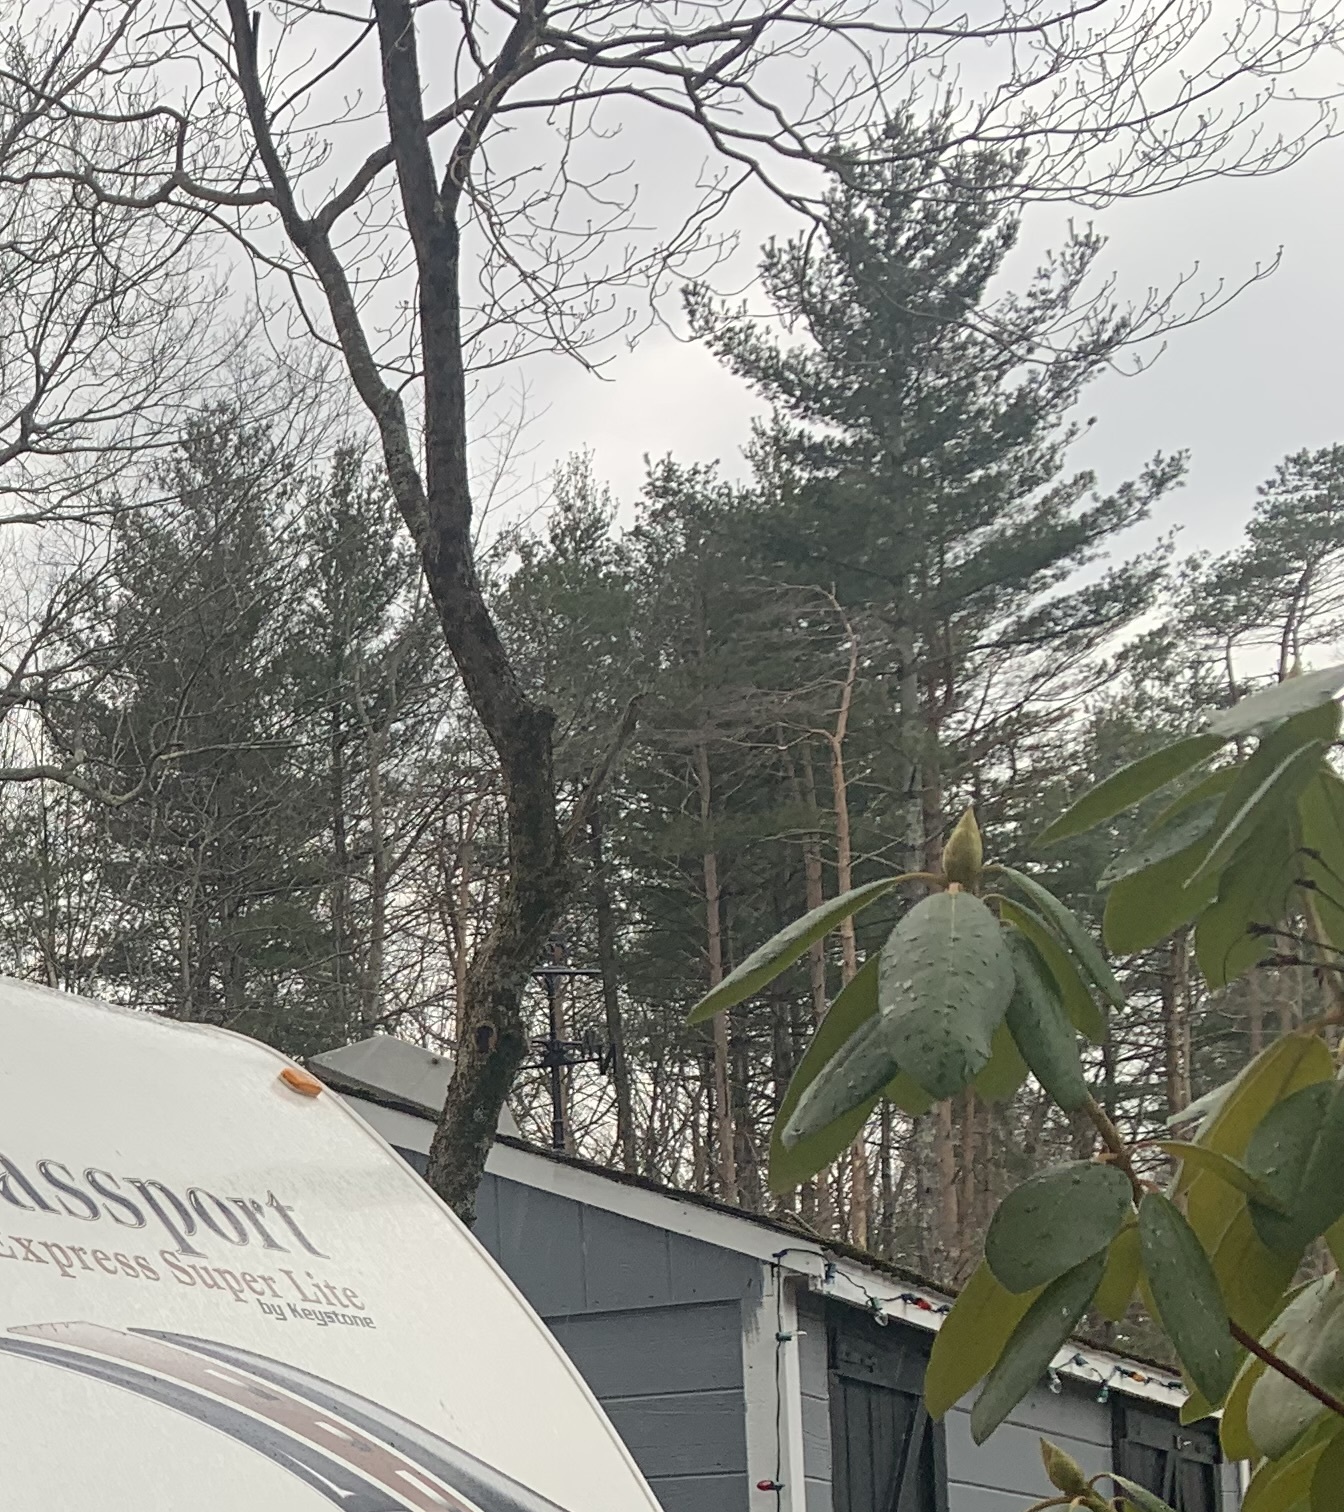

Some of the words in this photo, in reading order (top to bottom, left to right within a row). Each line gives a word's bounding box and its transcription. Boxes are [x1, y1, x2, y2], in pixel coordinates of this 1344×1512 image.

[159, 1249, 283, 1304] Super
[278, 1268, 366, 1311] Lite
[255, 1297, 288, 1322] by
[286, 1302, 377, 1329] Keystone
